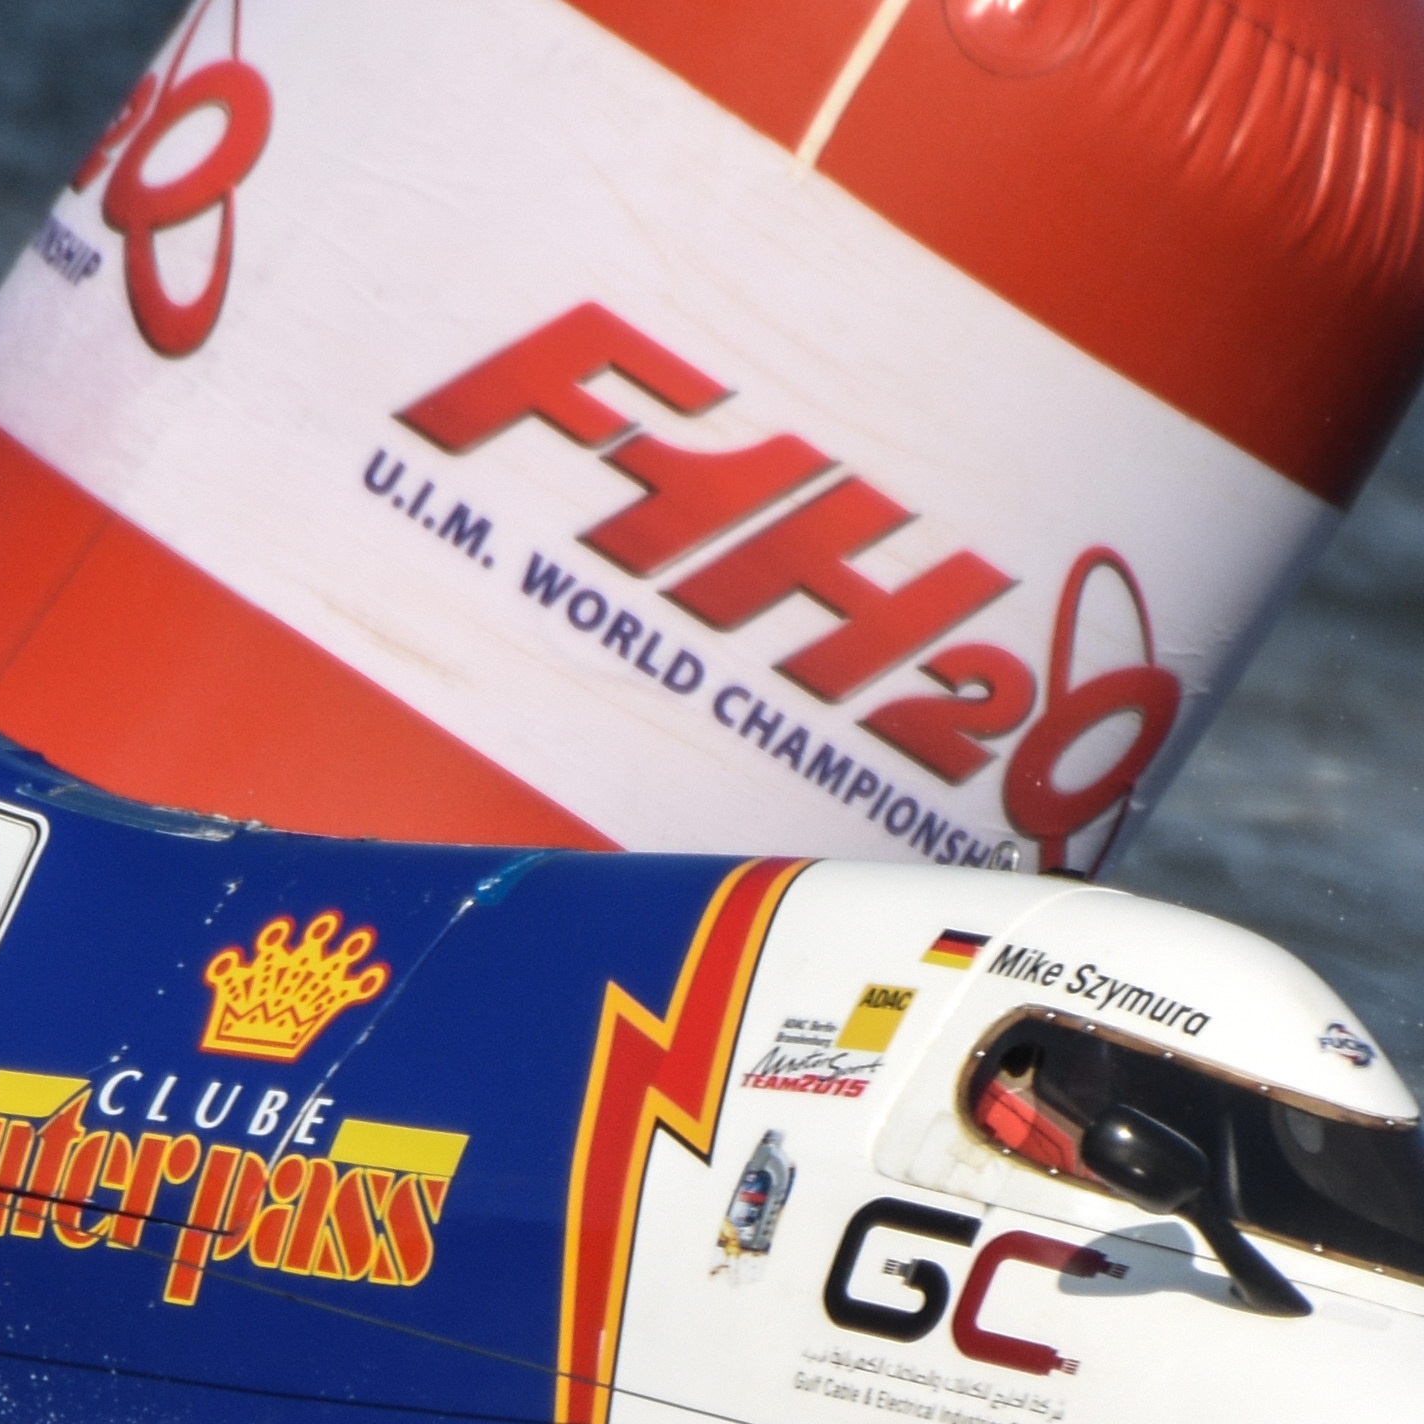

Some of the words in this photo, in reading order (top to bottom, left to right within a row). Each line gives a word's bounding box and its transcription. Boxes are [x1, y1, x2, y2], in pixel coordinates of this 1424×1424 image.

[363, 448, 495, 570] U.I.M.
[520, 551, 706, 696] WORLD
[712, 685, 1019, 875] CHAMPIONSH
[860, 987, 913, 1011] ADAC
[988, 943, 1065, 987] Mike
[1066, 963, 1212, 1037] Szymura
[98, 1069, 335, 1146] CLUBE
